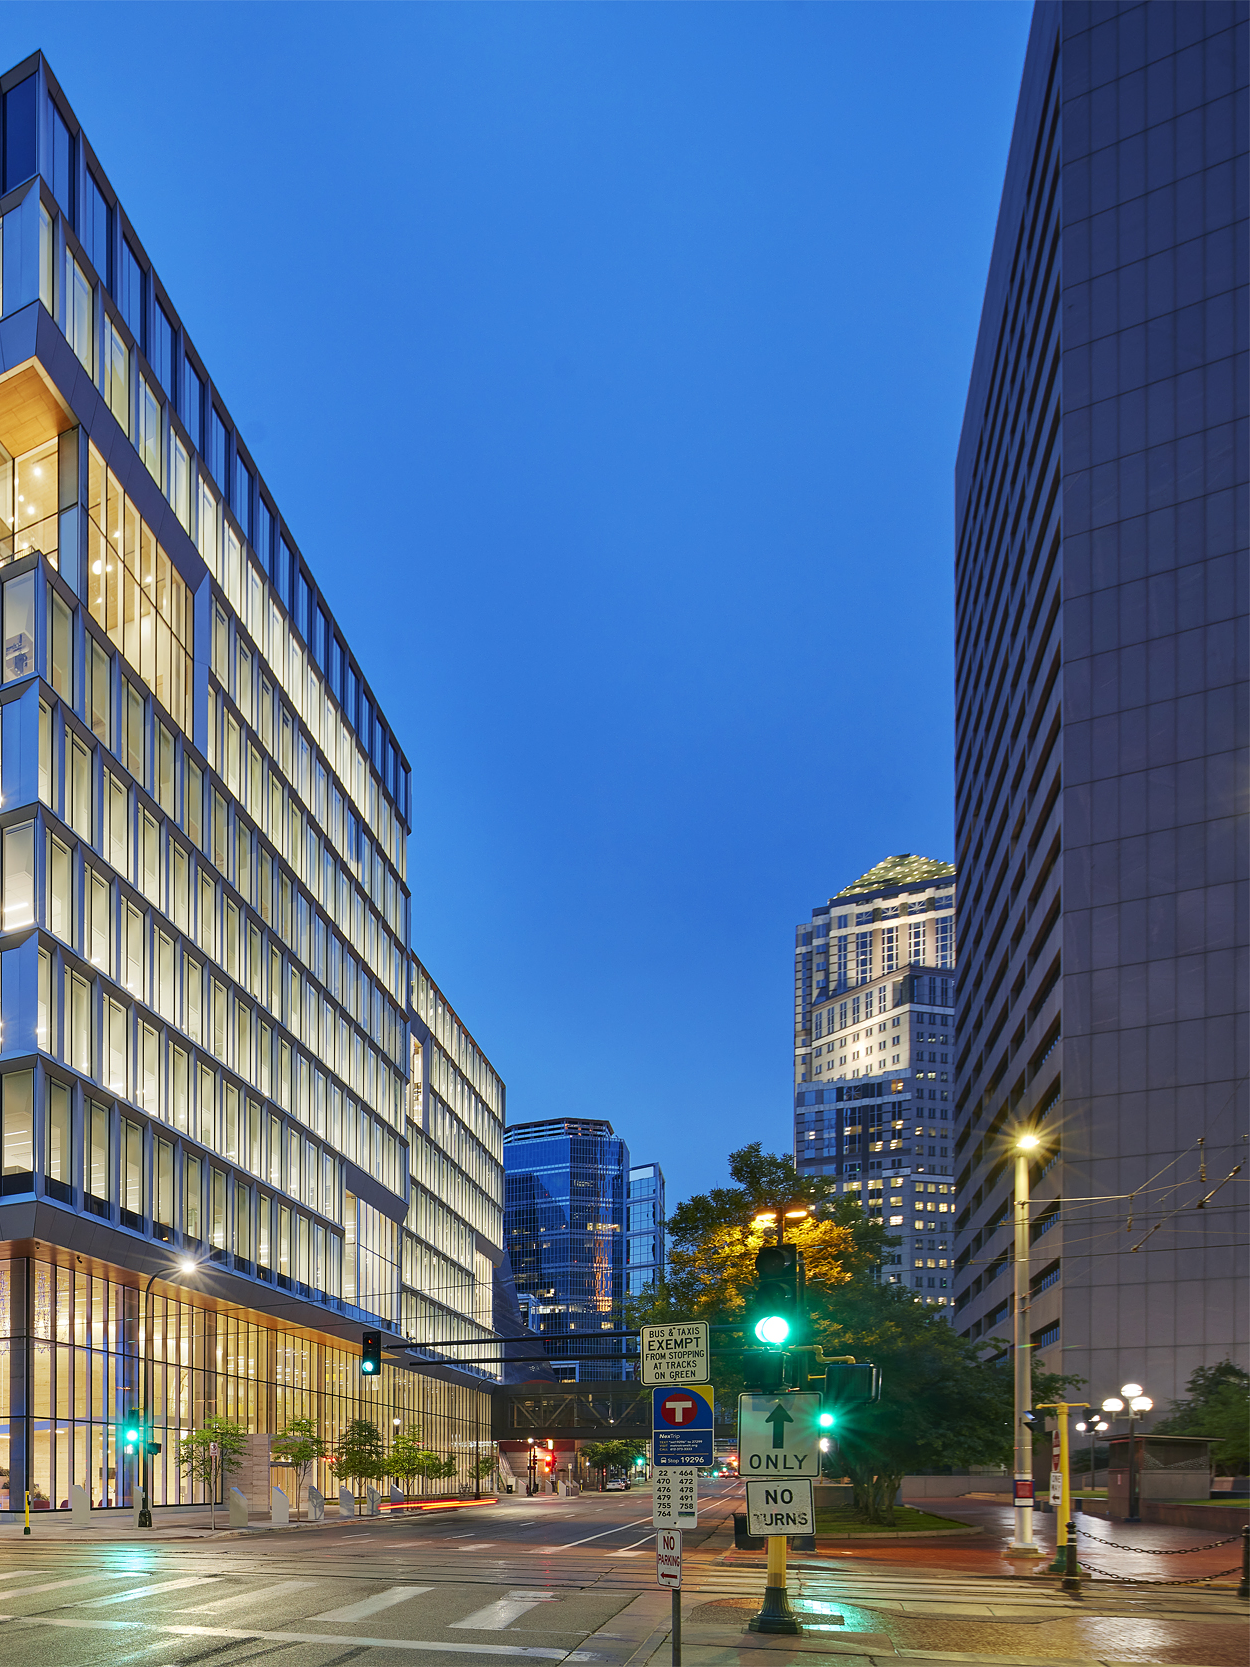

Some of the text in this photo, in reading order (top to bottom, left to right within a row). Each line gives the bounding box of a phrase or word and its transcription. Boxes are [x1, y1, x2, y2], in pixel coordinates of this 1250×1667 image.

[649, 1327, 700, 1338] BUS & TAXIS
[648, 1337, 701, 1351] EXEMPT
[645, 1350, 705, 1361] FROM STOPPING
[653, 1360, 697, 1370] AT TRACKS
[654, 1370, 696, 1380] ON GREEN
[665, 1401, 692, 1422] T
[749, 1454, 808, 1469] ONLY
[764, 1488, 793, 1505] NO
[662, 1535, 676, 1550] NO
[658, 1553, 680, 1567] PARKING
